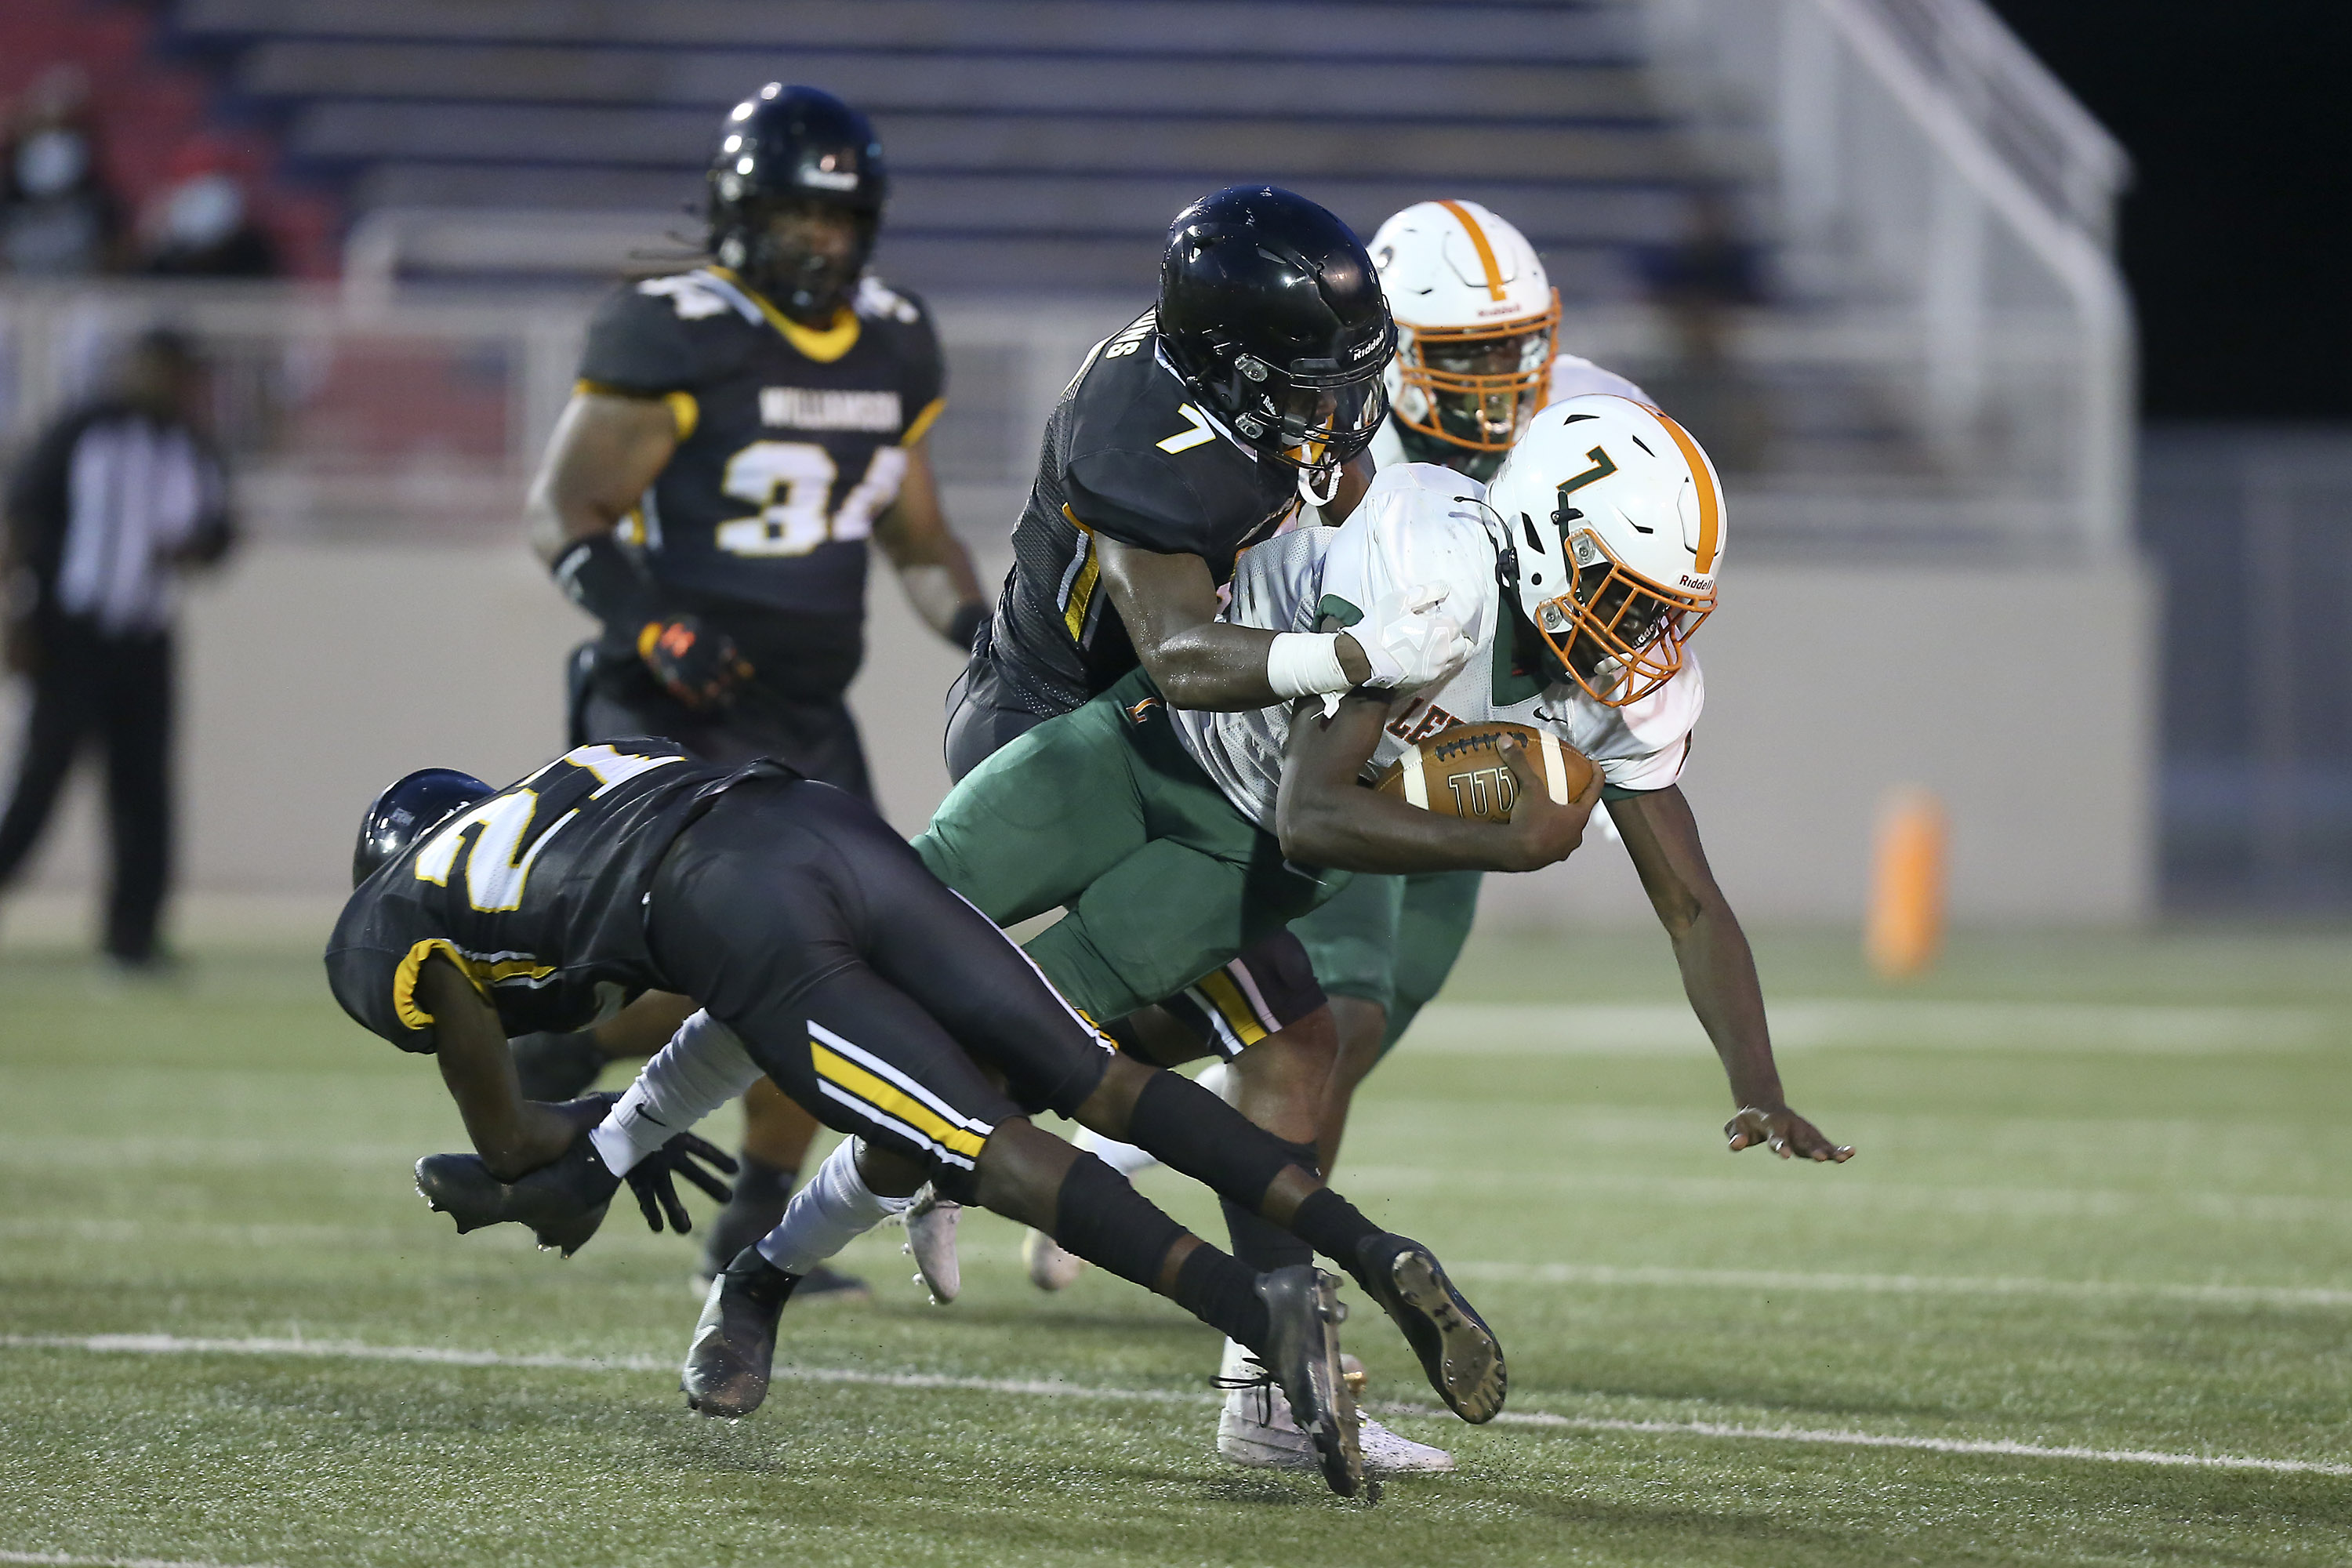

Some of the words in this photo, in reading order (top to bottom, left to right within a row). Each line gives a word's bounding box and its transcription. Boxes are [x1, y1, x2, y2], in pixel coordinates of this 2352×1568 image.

[1353, 328, 1385, 361] Riddell
[1155, 402, 1217, 455] 7
[1555, 445, 1619, 495] 7
[1679, 575, 1714, 590] Riddell
[1385, 697, 1467, 746] LE
